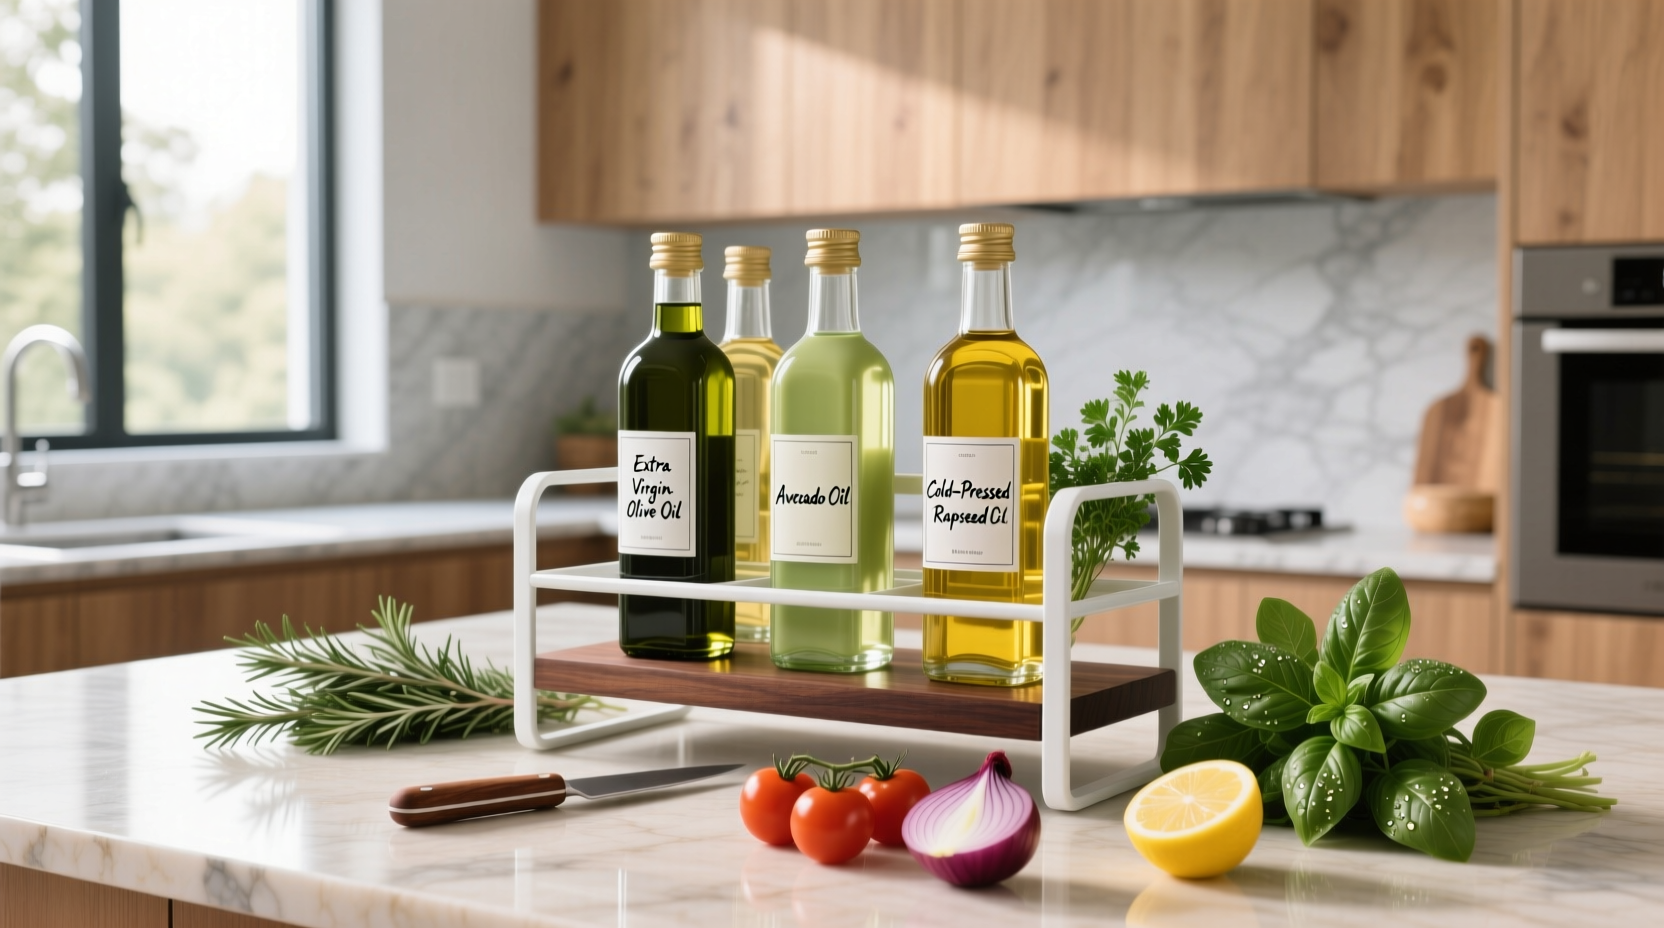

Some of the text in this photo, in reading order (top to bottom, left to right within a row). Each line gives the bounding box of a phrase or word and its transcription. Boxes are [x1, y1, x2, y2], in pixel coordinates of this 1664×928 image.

[633, 454, 672, 472] Extra
[632, 477, 674, 504] Virgin
[828, 485, 851, 506] Oil
[926, 479, 1012, 500] Cold-Pressed
[626, 499, 682, 520] Olive Oil
